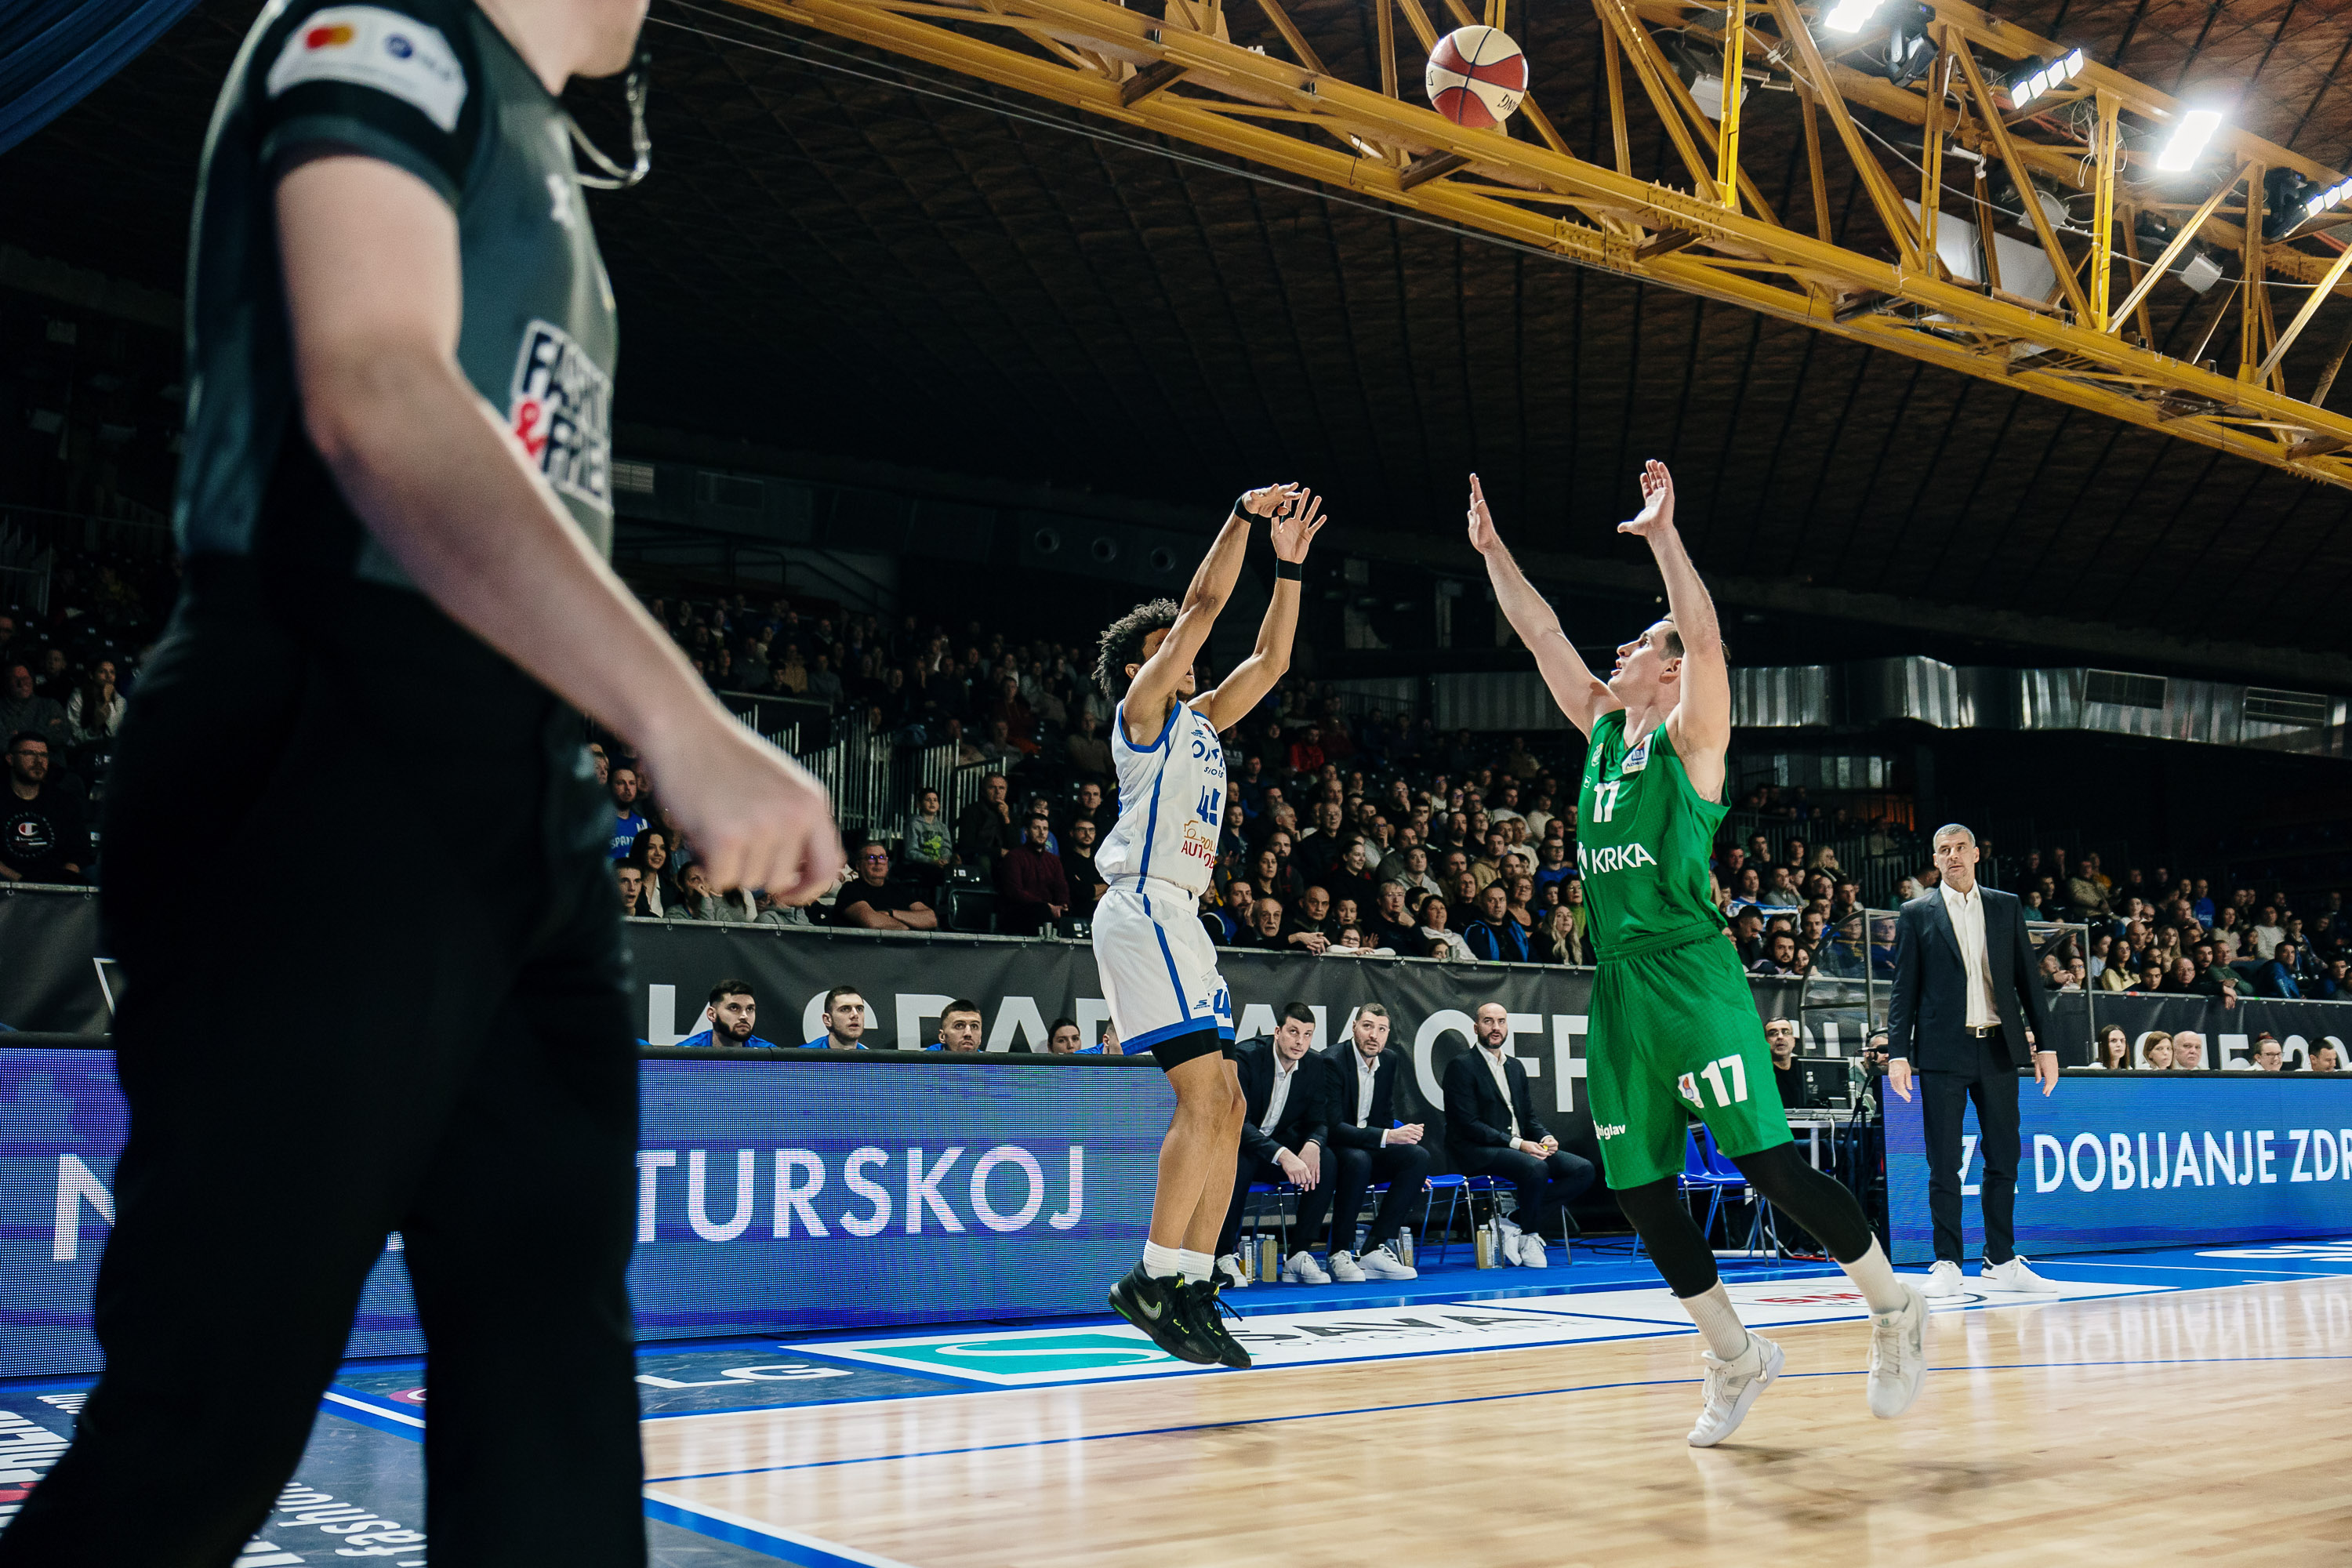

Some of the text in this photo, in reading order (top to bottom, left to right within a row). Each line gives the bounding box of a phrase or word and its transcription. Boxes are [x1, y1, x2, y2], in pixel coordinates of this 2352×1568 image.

[1593, 781, 1621, 823] 17
[1591, 843, 1657, 874] KRKA
[1213, 988, 1232, 1019] 4
[1700, 1054, 1748, 1108] 17
[1593, 1120, 1626, 1140] iglav
[2034, 1130, 2278, 1194] DOBIJANJE
[635, 1145, 1083, 1243] TURSKOJ
